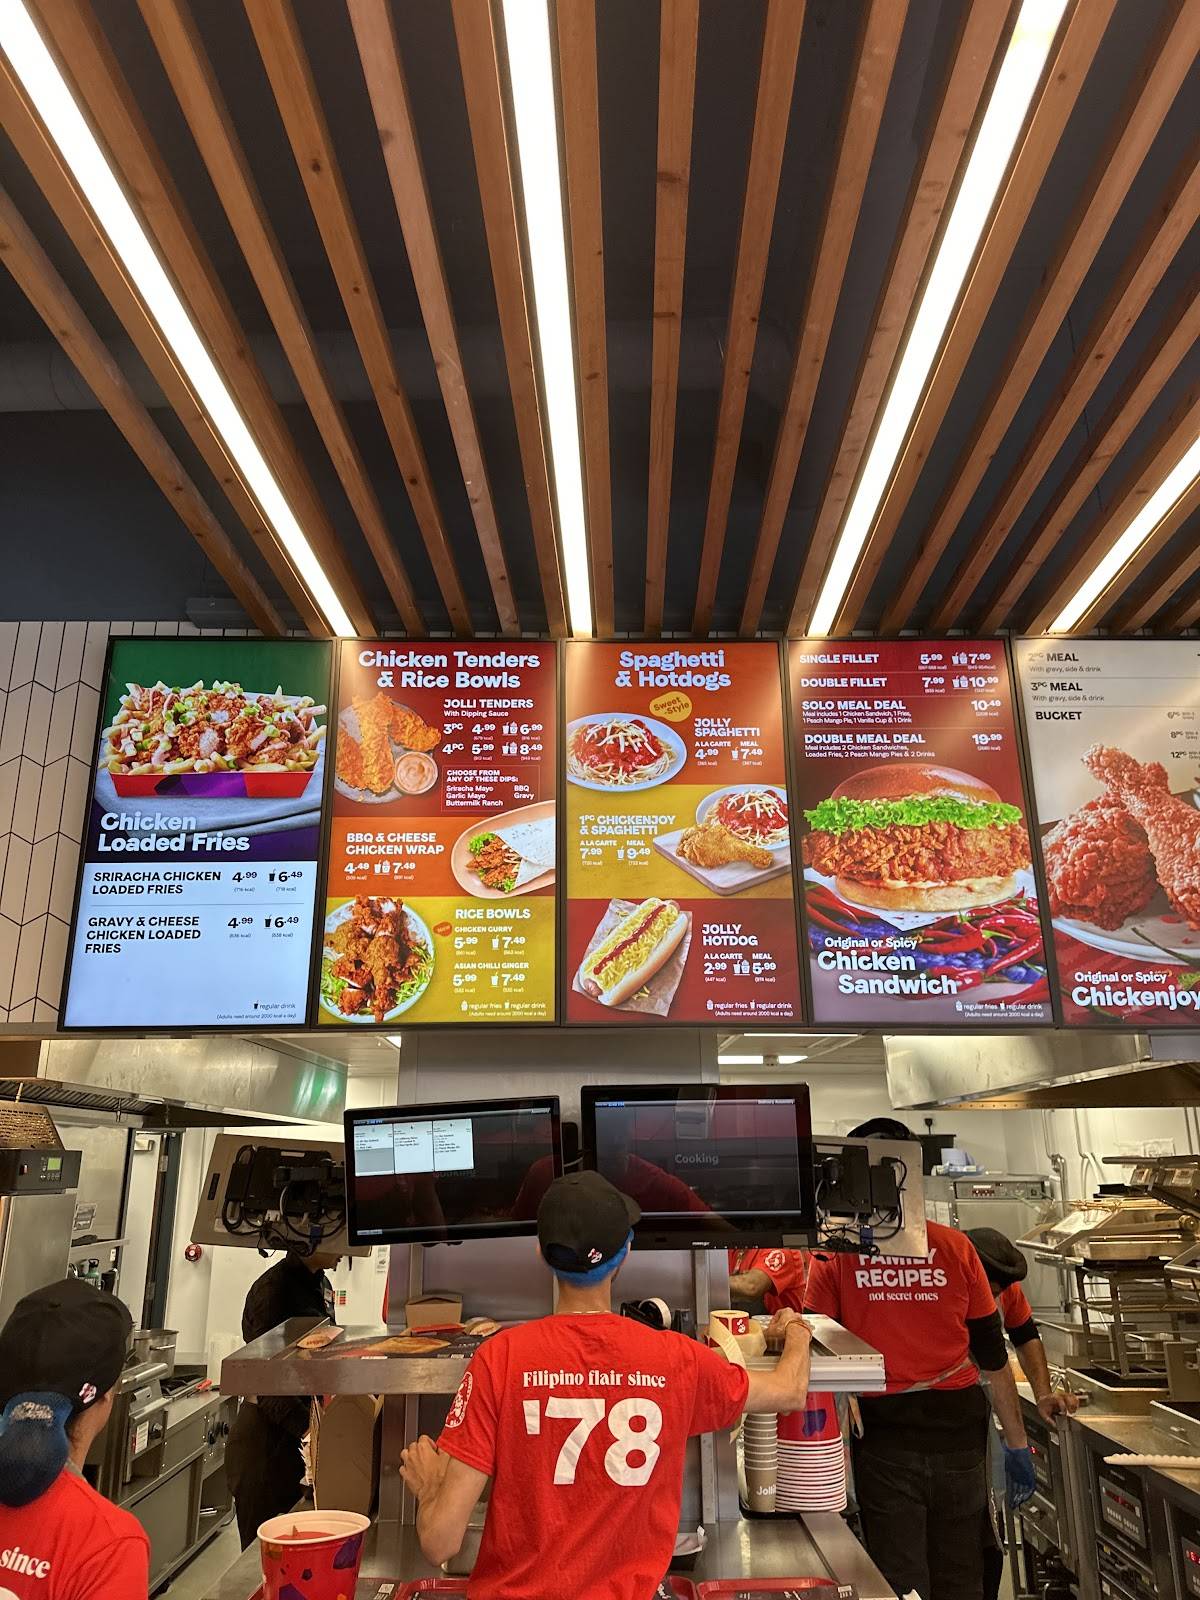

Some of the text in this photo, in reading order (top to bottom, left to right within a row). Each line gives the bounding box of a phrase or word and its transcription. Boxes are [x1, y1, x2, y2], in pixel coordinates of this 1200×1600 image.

[358, 650, 540, 668] Chicken Tenders
[620, 650, 725, 671] Spaghetti
[800, 654, 879, 664] SINGLE FILLET
[920, 654, 942, 664] 5.99
[968, 654, 991, 664] 7.99
[1046, 653, 1079, 661] MEAL
[377, 670, 520, 688] & Rice Bowls
[615, 671, 731, 691] & Hotdogs
[801, 678, 887, 687] DOUBLE FILLET
[922, 677, 944, 688] 7.99
[969, 677, 998, 688] 10.99
[1031, 682, 1082, 691] 3PC MEAL
[444, 699, 534, 708] JOLLI TENDERS
[654, 697, 680, 711] Sweet
[802, 700, 906, 710] SOLO MEAL DEAL
[1036, 712, 1082, 720] BUCKET
[694, 718, 731, 727] JOLLY
[443, 723, 463, 734] 3PC
[472, 724, 495, 734] 4.99
[520, 724, 543, 734] 6.99
[695, 728, 760, 737] SPAGHETTI
[804, 734, 926, 743] DOUBLE MEAL DEAL
[442, 743, 464, 754] 4PC
[472, 744, 494, 754] 5.99
[520, 744, 543, 754] 8.49
[695, 749, 718, 759] 4.99
[741, 749, 763, 759] 7.49
[100, 811, 197, 831] Chicken
[580, 815, 675, 825] 1PC CHICKENJOY
[580, 825, 658, 835] & SPAGHETTI
[98, 832, 250, 851] Loaded Fries
[347, 833, 436, 843] BBQ & CHEESE
[346, 845, 444, 855] CHICKEN WRAP
[580, 848, 602, 859] 7.99
[627, 848, 650, 859] 9.49
[344, 862, 369, 874] 4.49
[393, 862, 416, 874] 7.49
[94, 872, 221, 882] SRIRACHA CHICKEN
[232, 872, 257, 882] 4.99
[278, 871, 303, 882] 6.49
[92, 885, 183, 894] LOADED FRIES
[455, 909, 531, 918] RICE BOWLS
[88, 916, 199, 927] GRAVY & CHEESE
[228, 918, 253, 928] 4.99
[275, 917, 299, 928] 6.49
[702, 924, 741, 934] JOLLY
[87, 930, 201, 940] CHICKEN LOADED
[454, 937, 478, 949] 5.99
[502, 936, 526, 948] 7.49
[703, 936, 758, 946] HOTDOG
[825, 937, 917, 950] Original or Spicy
[85, 944, 121, 953] FRIES
[818, 950, 915, 971] Chicken
[704, 962, 727, 974] 2.99
[752, 962, 776, 974] 5.99
[453, 974, 477, 986] 5.99
[501, 974, 525, 986] 7.49
[1075, 971, 1167, 984] Original or Spicy
[838, 974, 958, 994] Sandwich
[1071, 985, 1200, 1011] Chickenjoy
[675, 1155, 719, 1165] Cooking
[855, 1269, 947, 1288] RECIPES
[869, 1292, 938, 1301] not secret ones
[523, 1370, 666, 1388] Filipino flair since
[522, 1396, 662, 1486] '78
[0, 1547, 50, 1578] since
